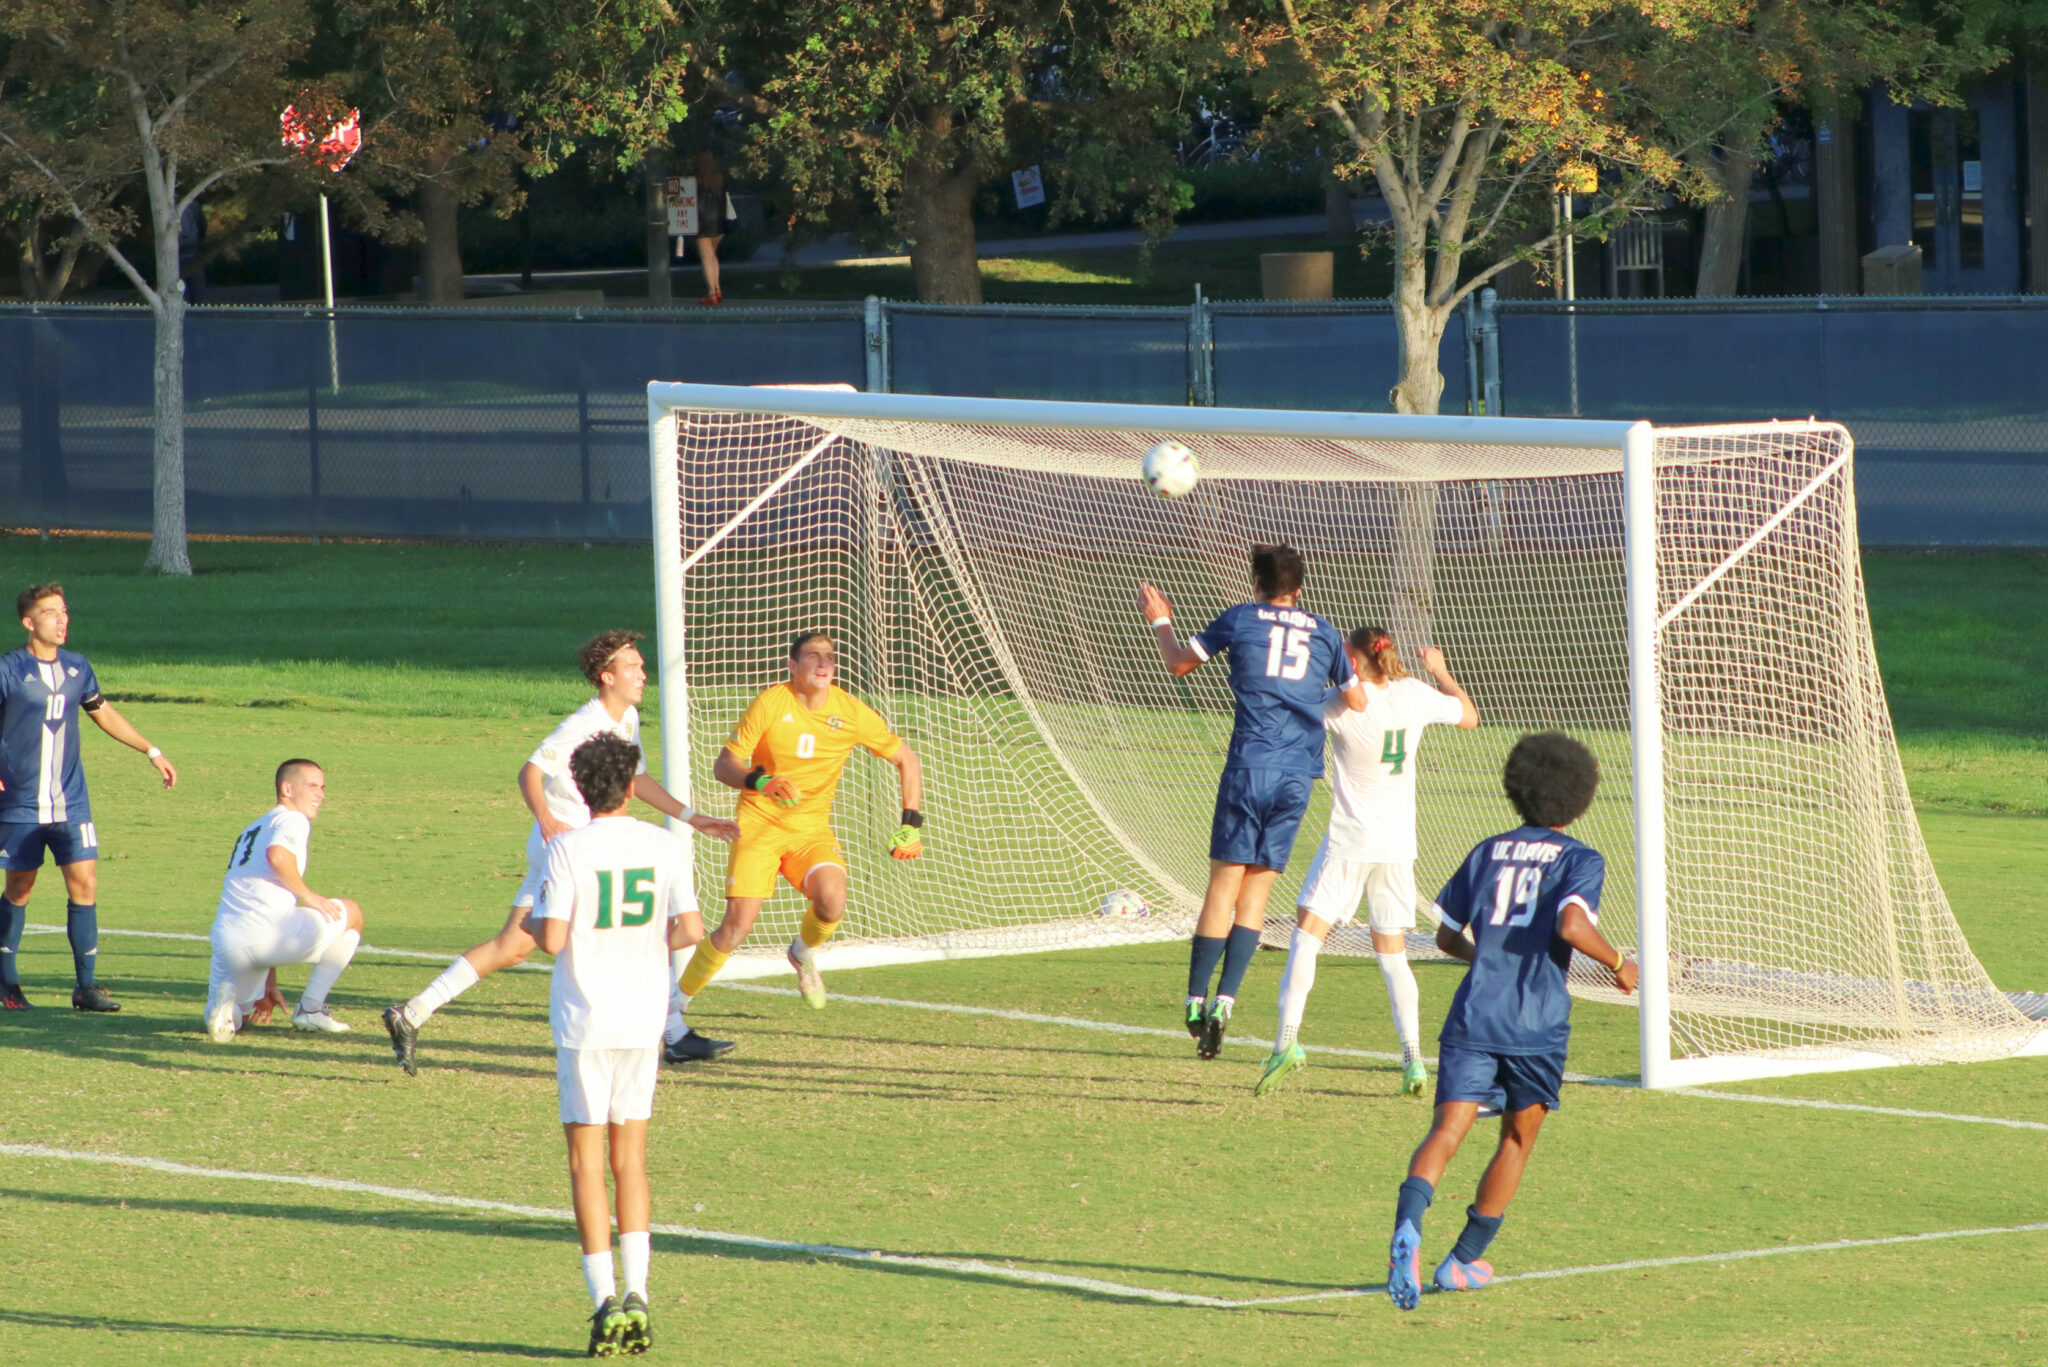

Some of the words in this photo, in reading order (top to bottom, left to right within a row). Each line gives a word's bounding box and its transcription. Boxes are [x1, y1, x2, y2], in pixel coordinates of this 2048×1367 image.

[677, 209, 688, 217] ANY
[677, 220, 689, 229] TIME
[1265, 625, 1311, 680] 15
[45, 693, 67, 721] 10
[796, 733, 815, 759] 0
[1380, 728, 1407, 776] 4
[79, 822, 98, 848] 10
[1491, 840, 1514, 861] UC
[1512, 841, 1562, 863] DAVIS
[593, 867, 656, 929] 15
[1489, 866, 1542, 928] 19
